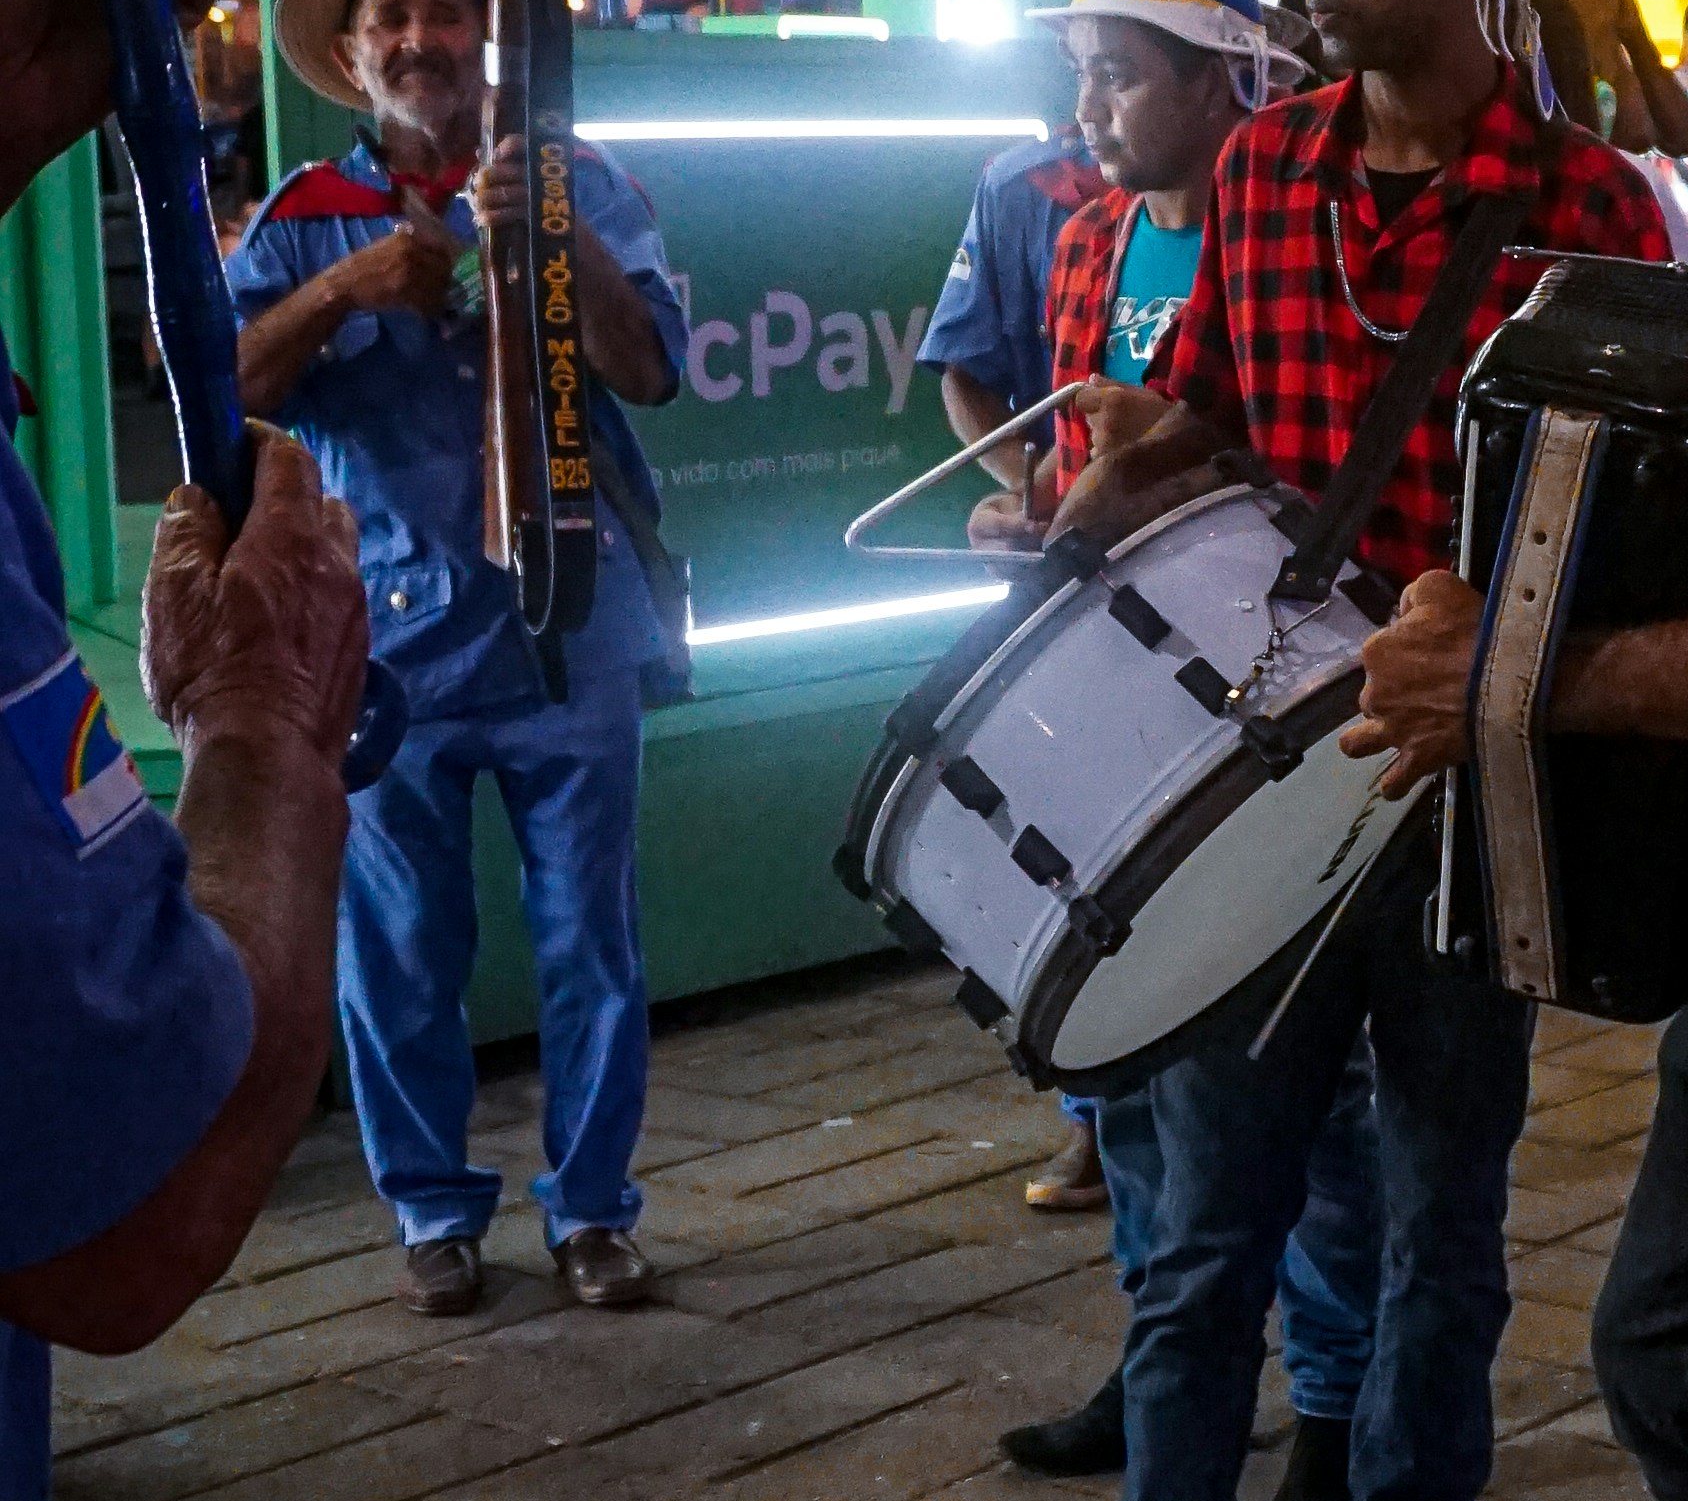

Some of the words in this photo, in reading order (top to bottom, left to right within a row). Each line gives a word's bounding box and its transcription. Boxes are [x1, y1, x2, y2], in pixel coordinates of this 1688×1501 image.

[539, 142, 571, 236] COSMO
[547, 338, 580, 447] MACIEL
[550, 457, 591, 491] B25
